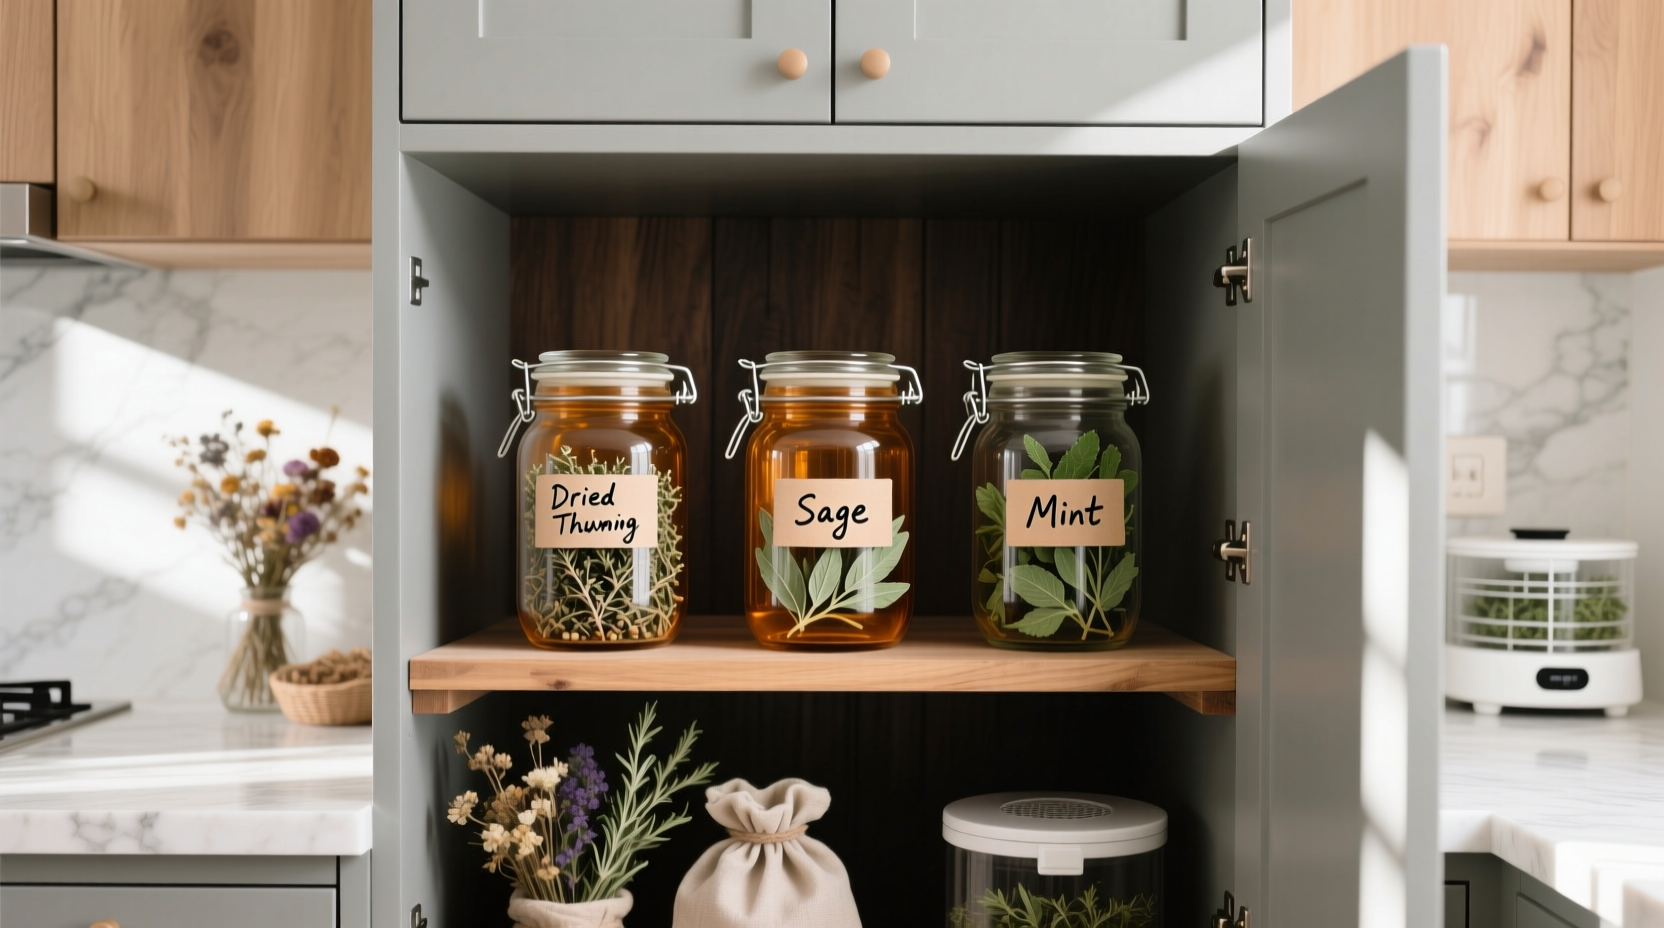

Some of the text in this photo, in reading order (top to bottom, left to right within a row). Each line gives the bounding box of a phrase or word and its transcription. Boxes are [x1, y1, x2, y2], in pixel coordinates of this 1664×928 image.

[551, 481, 616, 510] Dried
[1025, 493, 1105, 529] Mint
[794, 493, 869, 541] Sage
